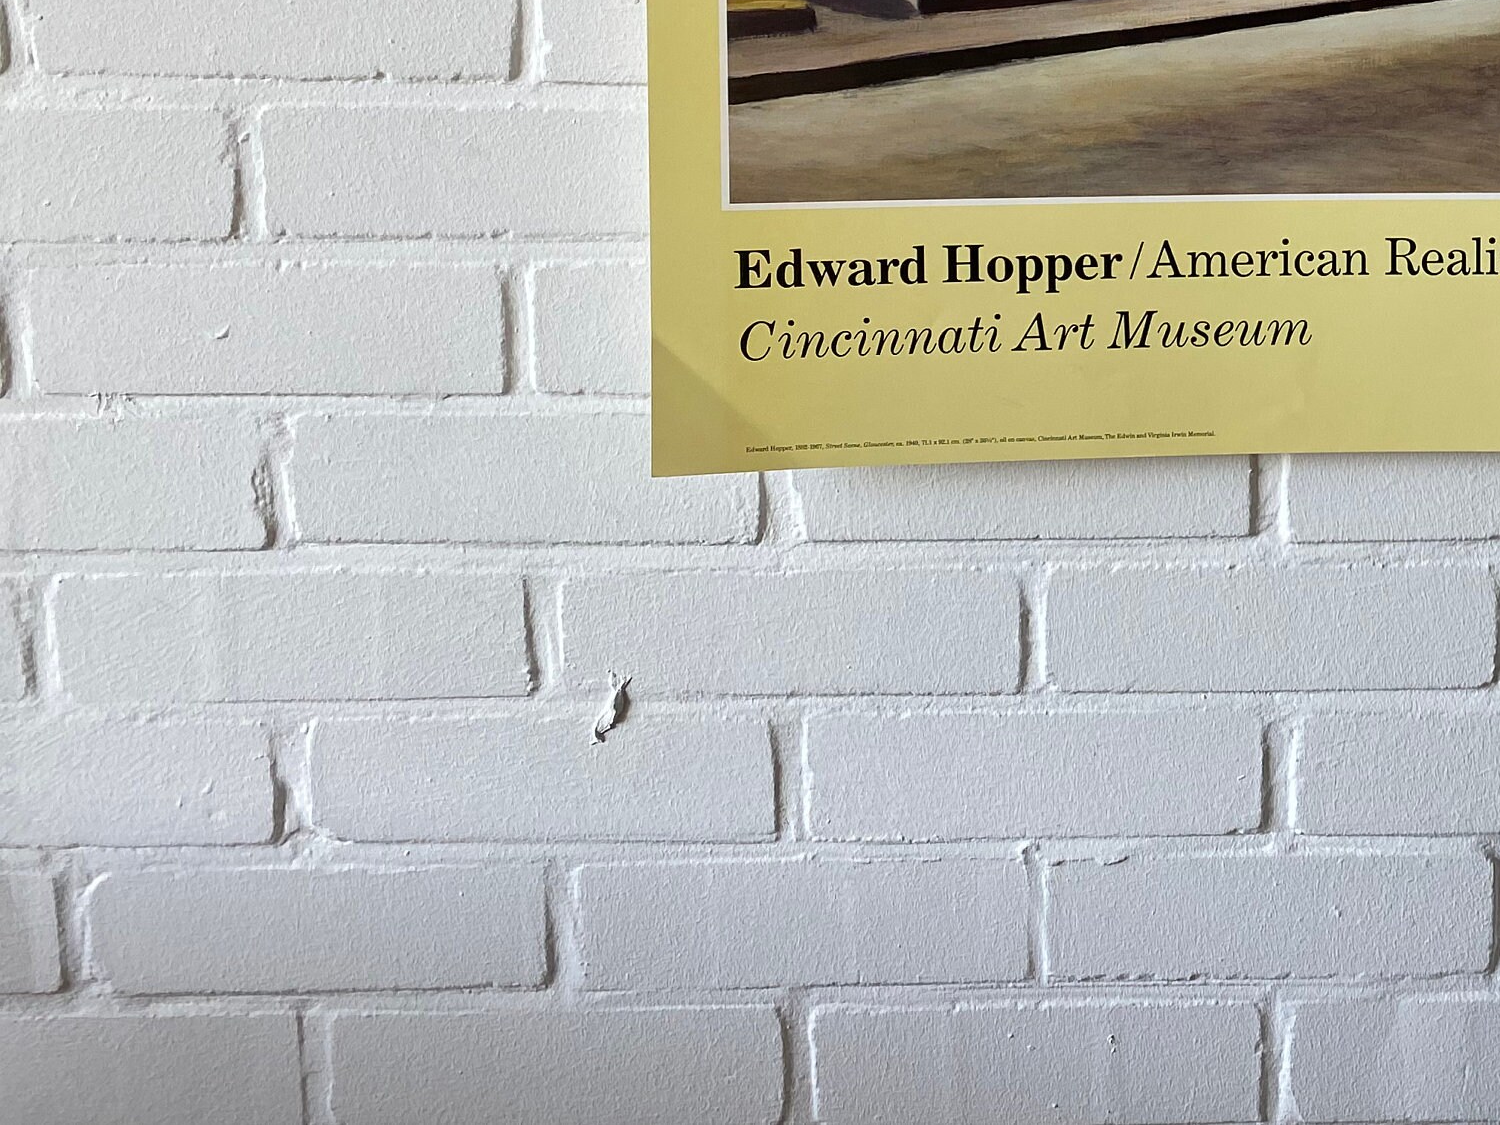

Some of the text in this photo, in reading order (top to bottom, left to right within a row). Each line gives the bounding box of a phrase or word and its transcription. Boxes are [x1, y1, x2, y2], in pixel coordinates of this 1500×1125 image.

[733, 244, 929, 290] Edward
[739, 310, 1313, 362] Cincinnati Art Museum
[745, 445, 769, 453] Edward
[1105, 432, 1116, 441] The
